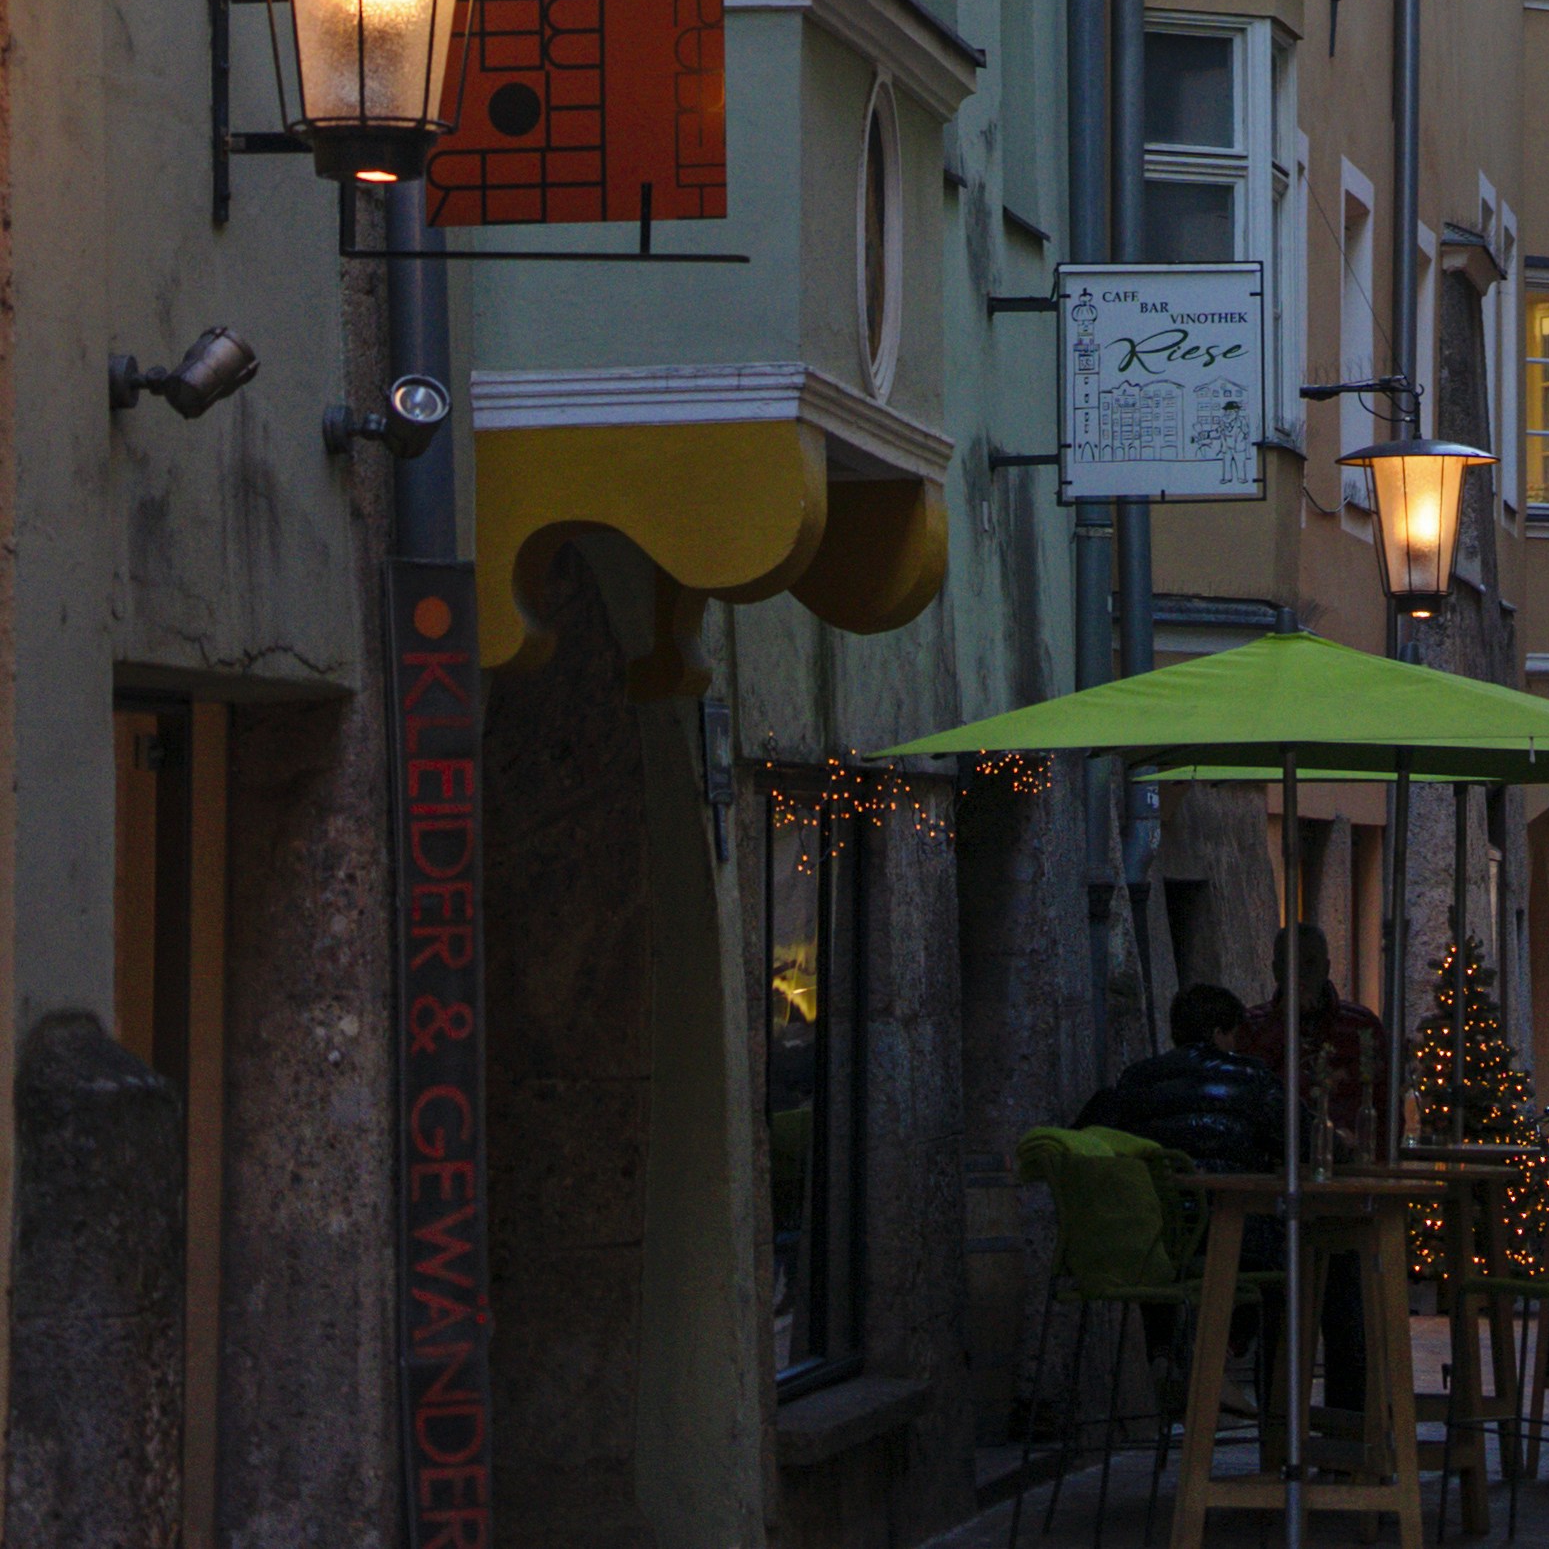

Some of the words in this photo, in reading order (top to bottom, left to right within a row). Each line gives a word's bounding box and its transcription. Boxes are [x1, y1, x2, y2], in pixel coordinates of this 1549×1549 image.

[1140, 302, 1169, 314] BAR
[1170, 312, 1248, 324] VINOTHEK
[1104, 328, 1250, 375] Riese
[402, 653, 475, 972] KLEIDER
[408, 994, 474, 1055] &
[410, 1084, 488, 1549] GEWÄNDER
